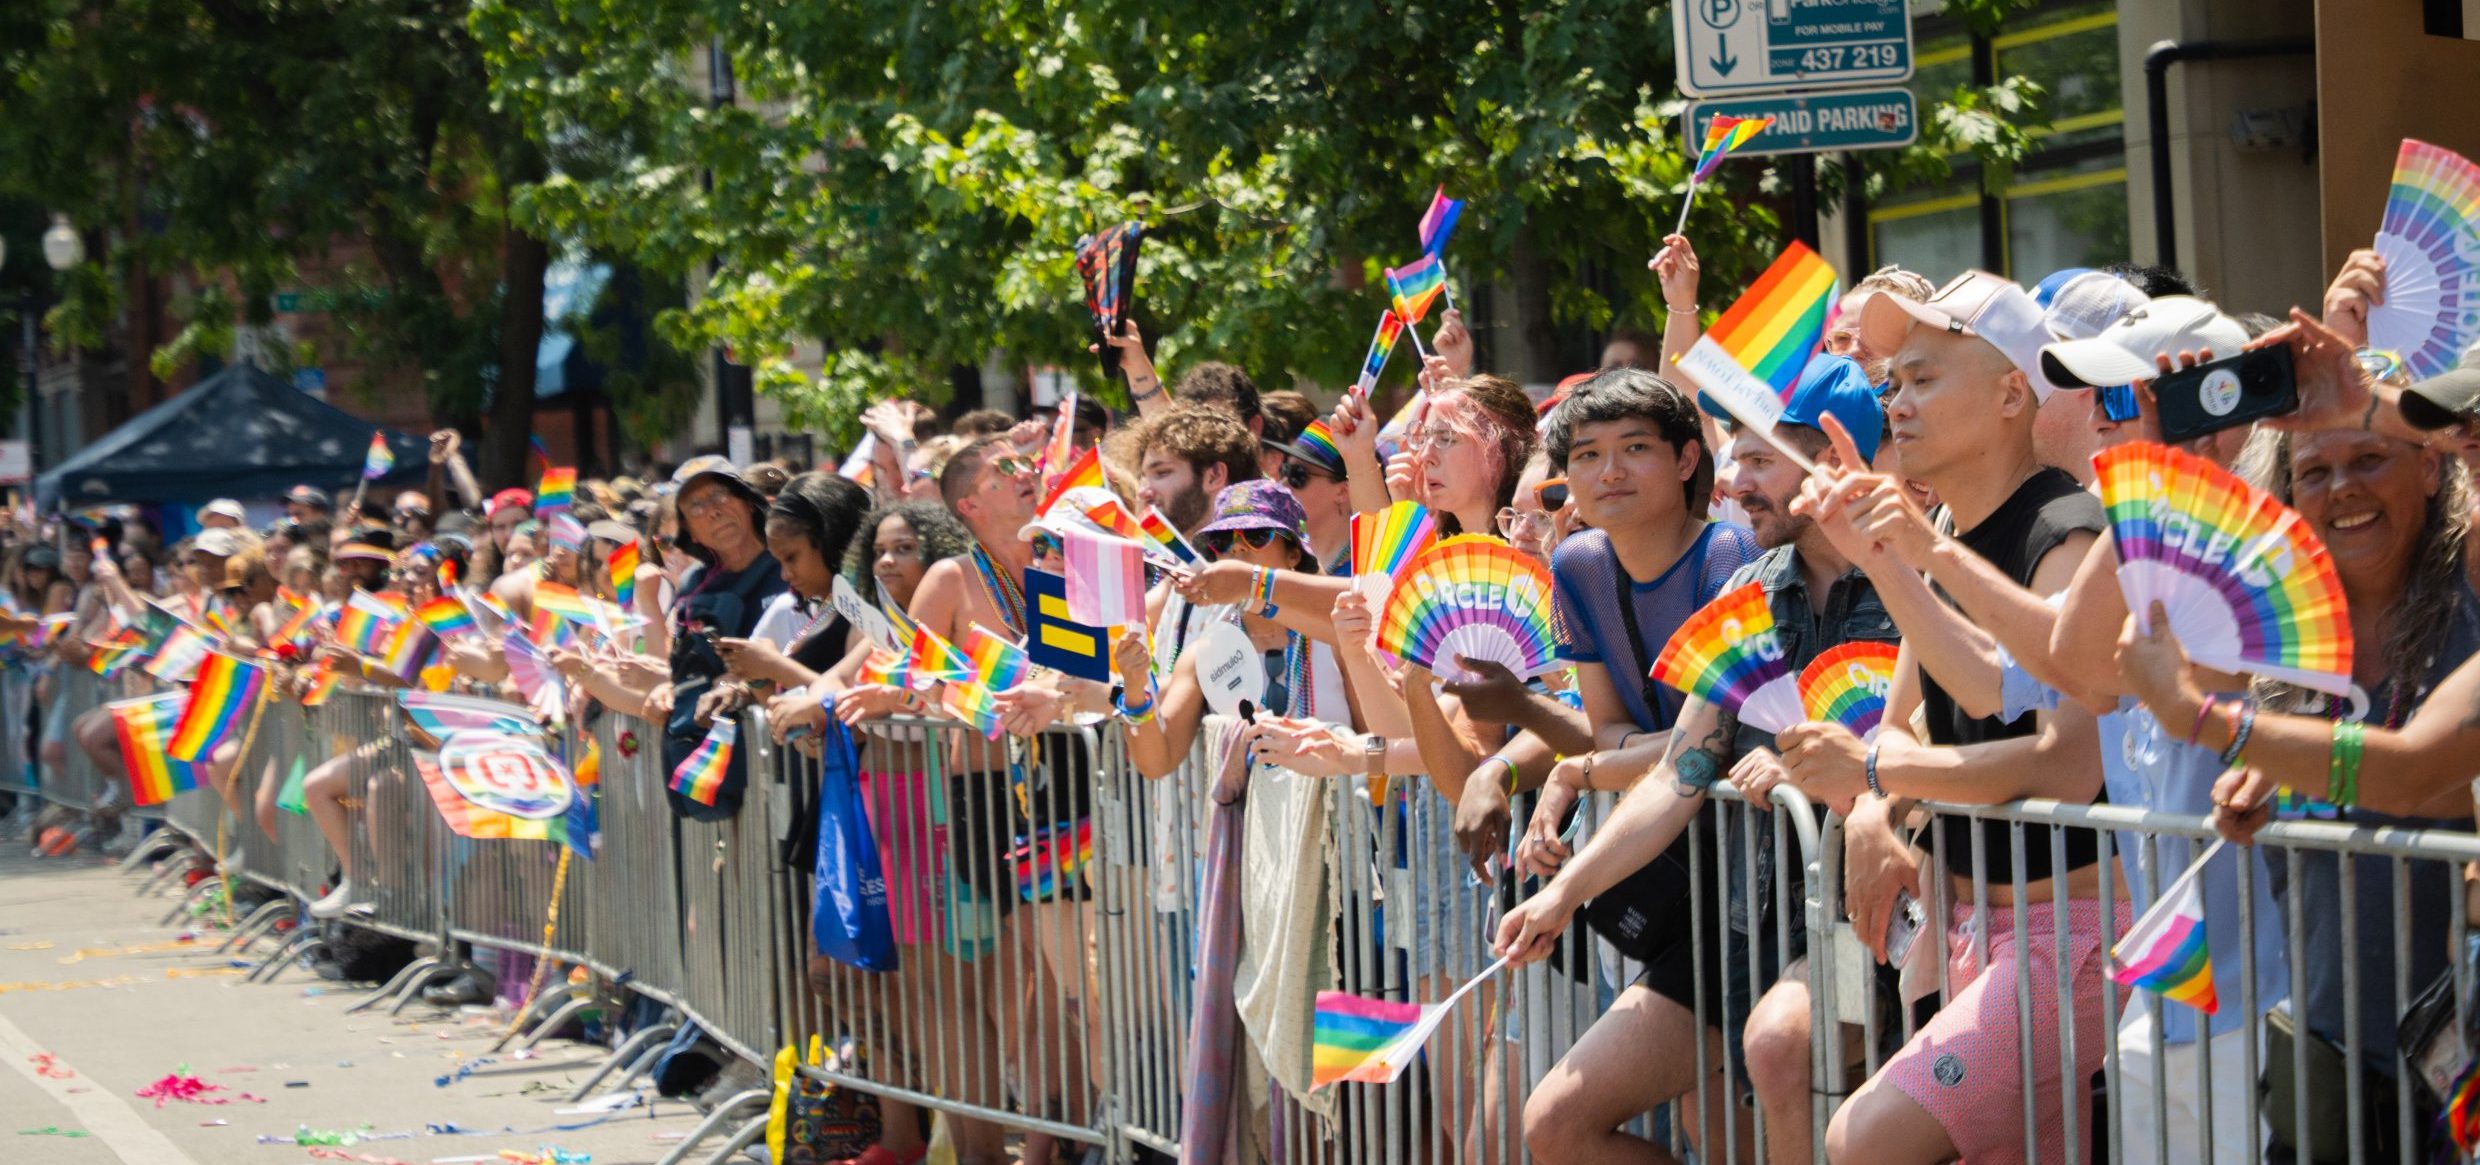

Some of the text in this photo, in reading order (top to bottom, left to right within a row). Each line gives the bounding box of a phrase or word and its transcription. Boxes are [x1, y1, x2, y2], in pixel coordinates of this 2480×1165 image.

[1795, 21, 1885, 36] FOR MOBILE PAY
[1801, 47, 1844, 70] 437
[1852, 44, 1897, 68] 219
[1764, 109, 1812, 135] PAID
[1847, 662, 1893, 699] CIR
